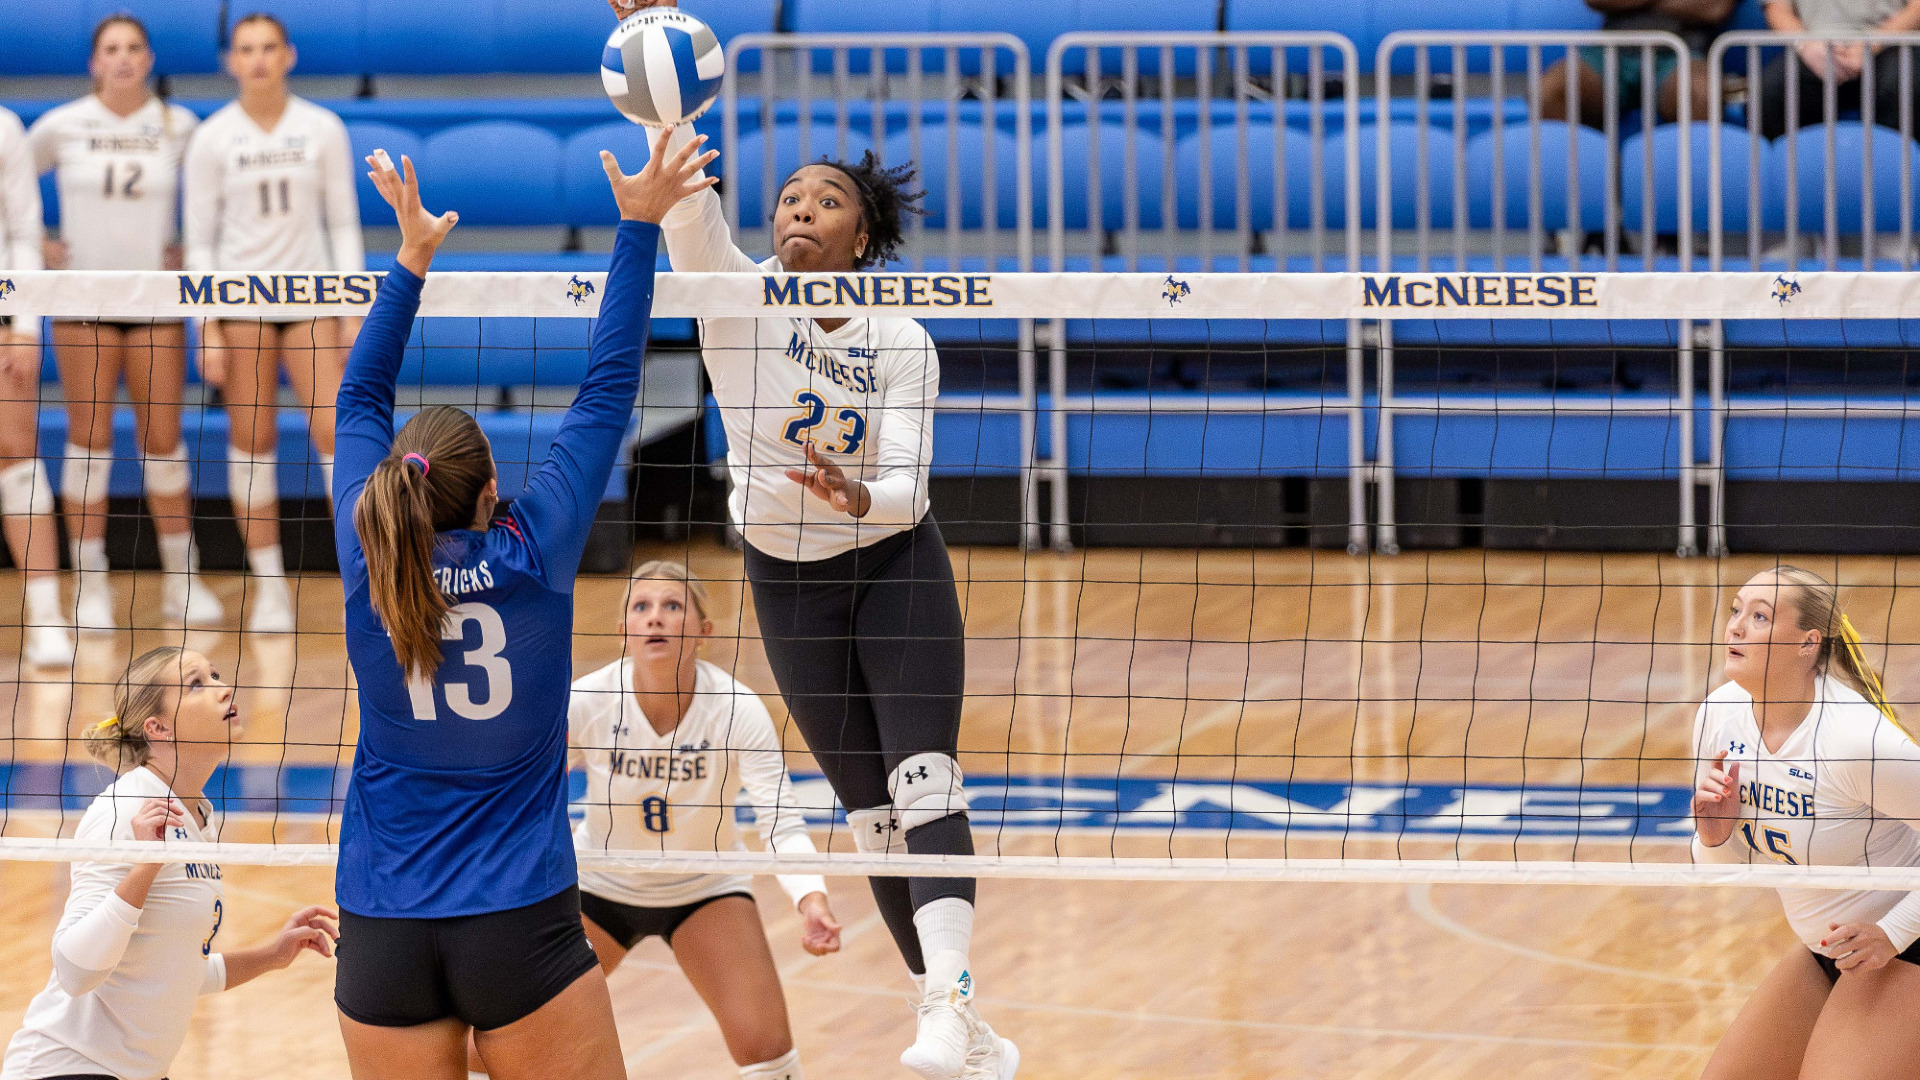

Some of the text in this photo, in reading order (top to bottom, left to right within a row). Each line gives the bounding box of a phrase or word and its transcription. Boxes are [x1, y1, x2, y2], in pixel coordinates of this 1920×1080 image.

[102, 162, 145, 199] 12
[258, 179, 291, 216] 11
[178, 274, 389, 305] McNEES
[762, 275, 994, 307] McNEESE
[1361, 275, 1599, 307] McNEESE
[781, 388, 869, 455] 23
[608, 751, 707, 781] McNEESE
[1788, 768, 1815, 781] SLC
[638, 792, 675, 836] 8
[1738, 780, 1816, 818] cNEESE
[1739, 819, 1800, 866] 15
[201, 895, 223, 960] 3
